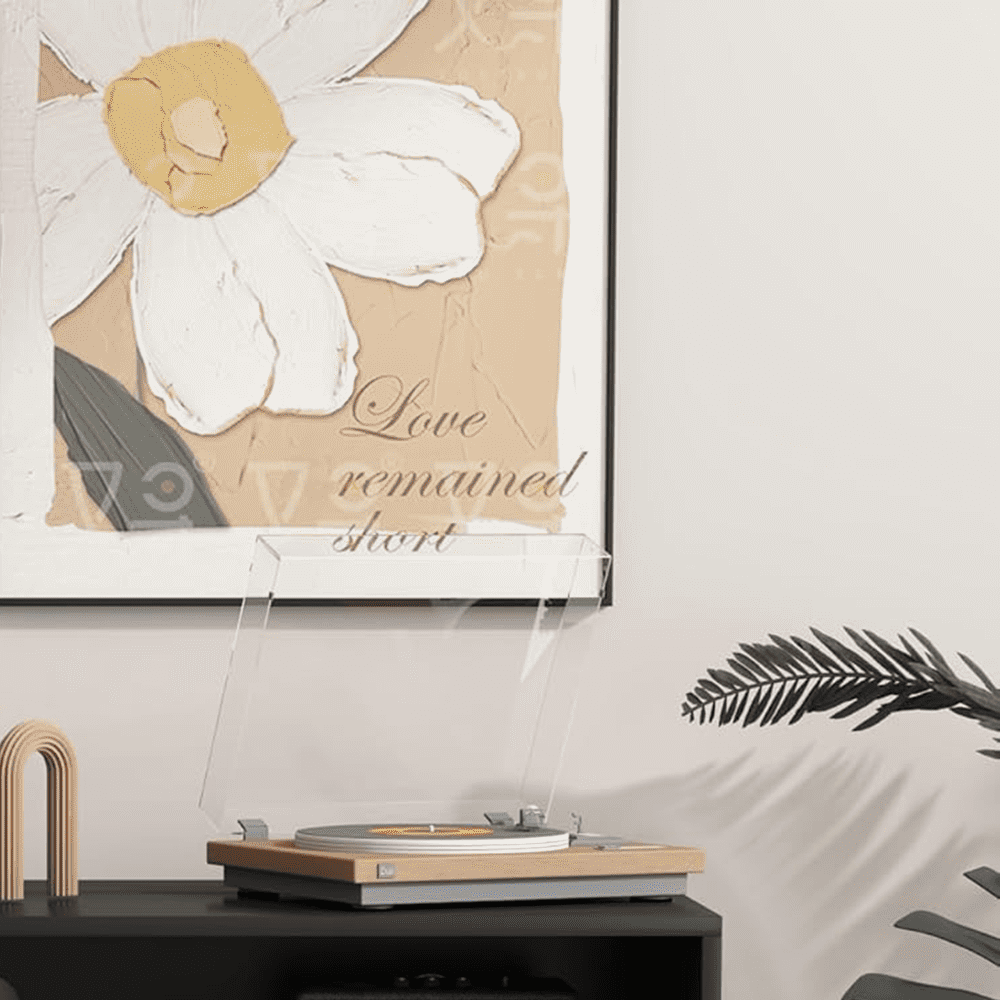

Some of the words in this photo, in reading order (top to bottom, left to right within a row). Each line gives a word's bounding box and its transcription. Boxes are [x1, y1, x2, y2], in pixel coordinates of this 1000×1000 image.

[340, 375, 488, 441] Love
[337, 451, 588, 498] remained
[332, 510, 457, 553] short
